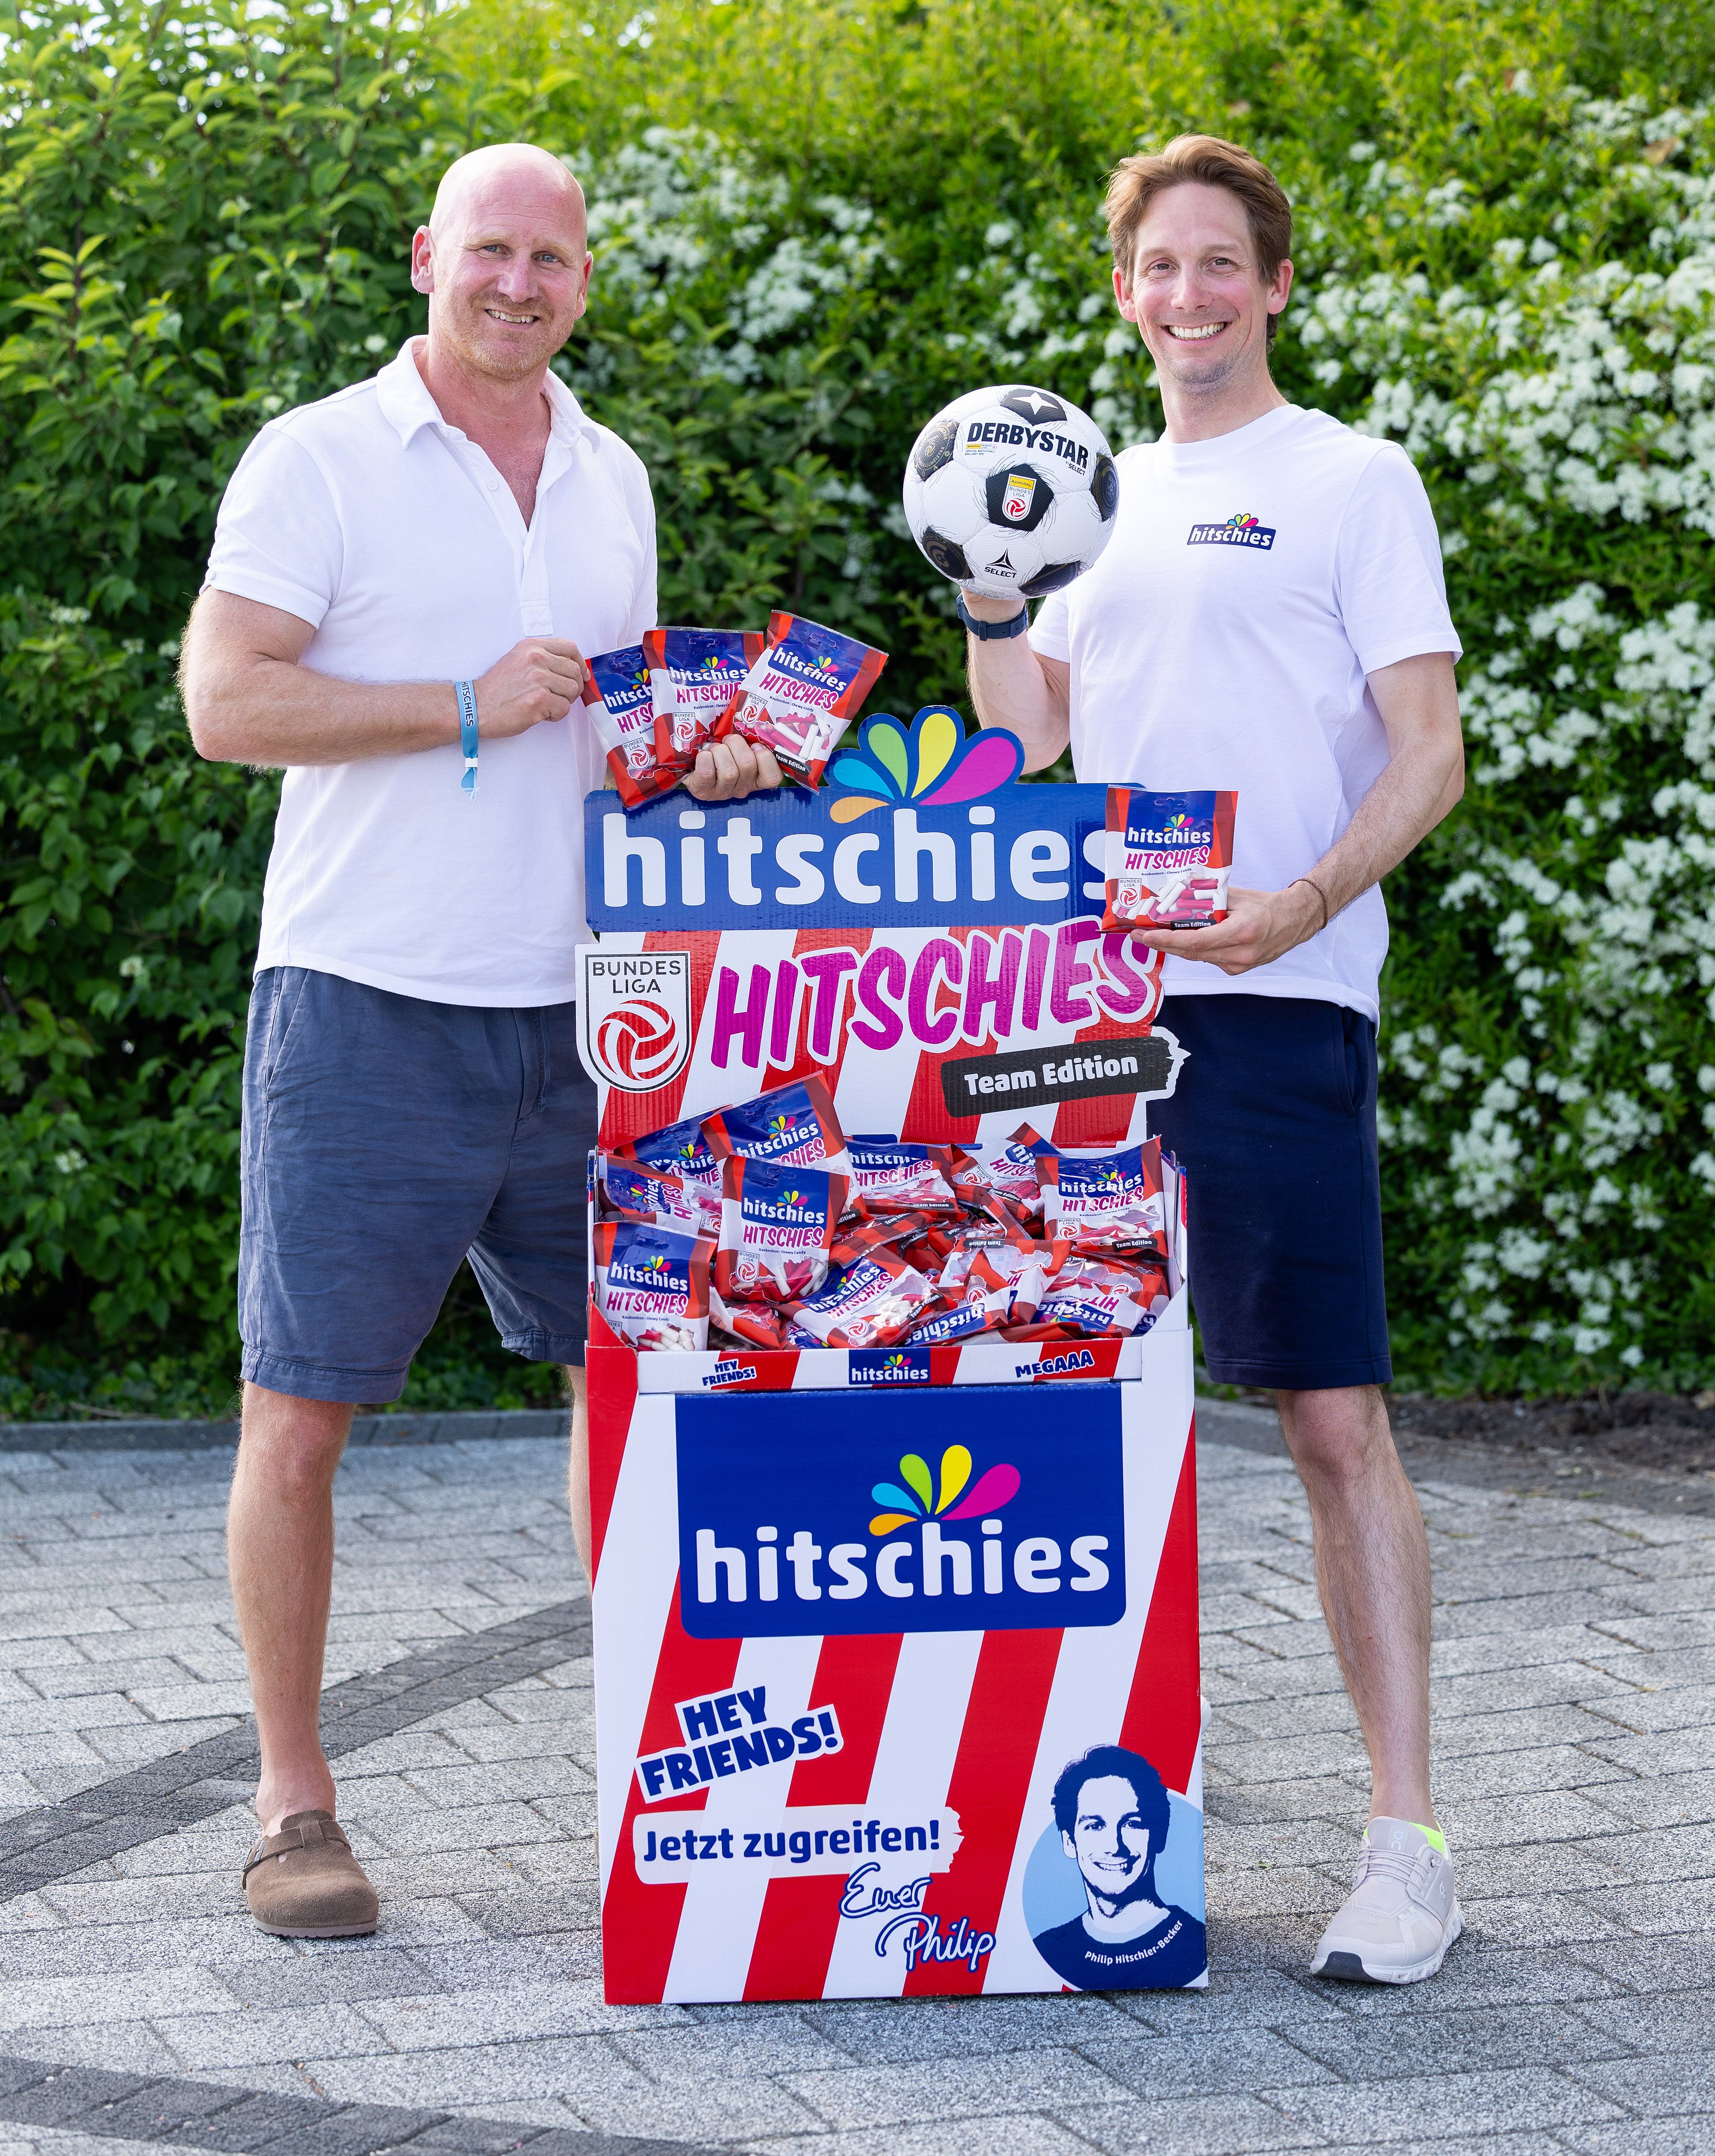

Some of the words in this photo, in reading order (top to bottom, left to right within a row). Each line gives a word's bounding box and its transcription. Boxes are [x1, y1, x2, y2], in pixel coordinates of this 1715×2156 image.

[967, 422, 1089, 469] DERBYSTAR
[1068, 463, 1085, 476] SELECT
[1190, 527, 1272, 546] hitschies
[984, 567, 1017, 578] SELECT
[669, 667, 748, 681] hitschies
[773, 647, 847, 691] hitschies
[604, 685, 652, 707] hitsch
[677, 682, 742, 704] HITSCHIE
[749, 695, 766, 704] BUNDES
[759, 672, 838, 709] HITSCHIES
[770, 696, 790, 705] Kaubonbon
[461, 681, 474, 727] HITSCHIES
[624, 739, 643, 749] BUNDES
[775, 754, 788, 763] Team
[788, 759, 806, 772] Edition
[1128, 827, 1211, 844] hitschies
[1125, 846, 1209, 870] HITSCHIES
[592, 960, 681, 976] BUNDES
[612, 978, 661, 994] LIGA
[711, 920, 1151, 1069] HITSCHIES
[965, 1070, 1036, 1097] Team
[1042, 1055, 1139, 1086] Edition
[977, 1166, 992, 1180] BUNDES
[977, 1171, 985, 1179] LIGA
[1061, 1174, 1142, 1193] hitschies
[744, 1197, 825, 1224] hitschies
[1062, 1187, 1142, 1212] HITSCHIES
[838, 1213, 856, 1224] dition
[743, 1225, 822, 1248] HITSCHIES
[611, 1261, 688, 1291] hitschies
[606, 1291, 687, 1314] HITSCHIES
[910, 1305, 923, 1318] Team
[1038, 1302, 1110, 1325] hitschie
[702, 1365, 755, 1386] FRIENDS!
[715, 1360, 737, 1372] HEY
[851, 1367, 928, 1381] hitschies
[1015, 1351, 1094, 1378] MEGAAA
[695, 1519, 1110, 1603] hitschies
[682, 1686, 766, 1741] HEY
[640, 1711, 838, 1796] FRIENDS!
[644, 1828, 734, 1861] Jetzt
[743, 1819, 940, 1863] zugreifen!
[838, 1862, 933, 1918] Euer
[875, 1912, 996, 1972] Philip
[1085, 1951, 1113, 1966] Philip
[1115, 1920, 1183, 1964] Hitschler-Becker
